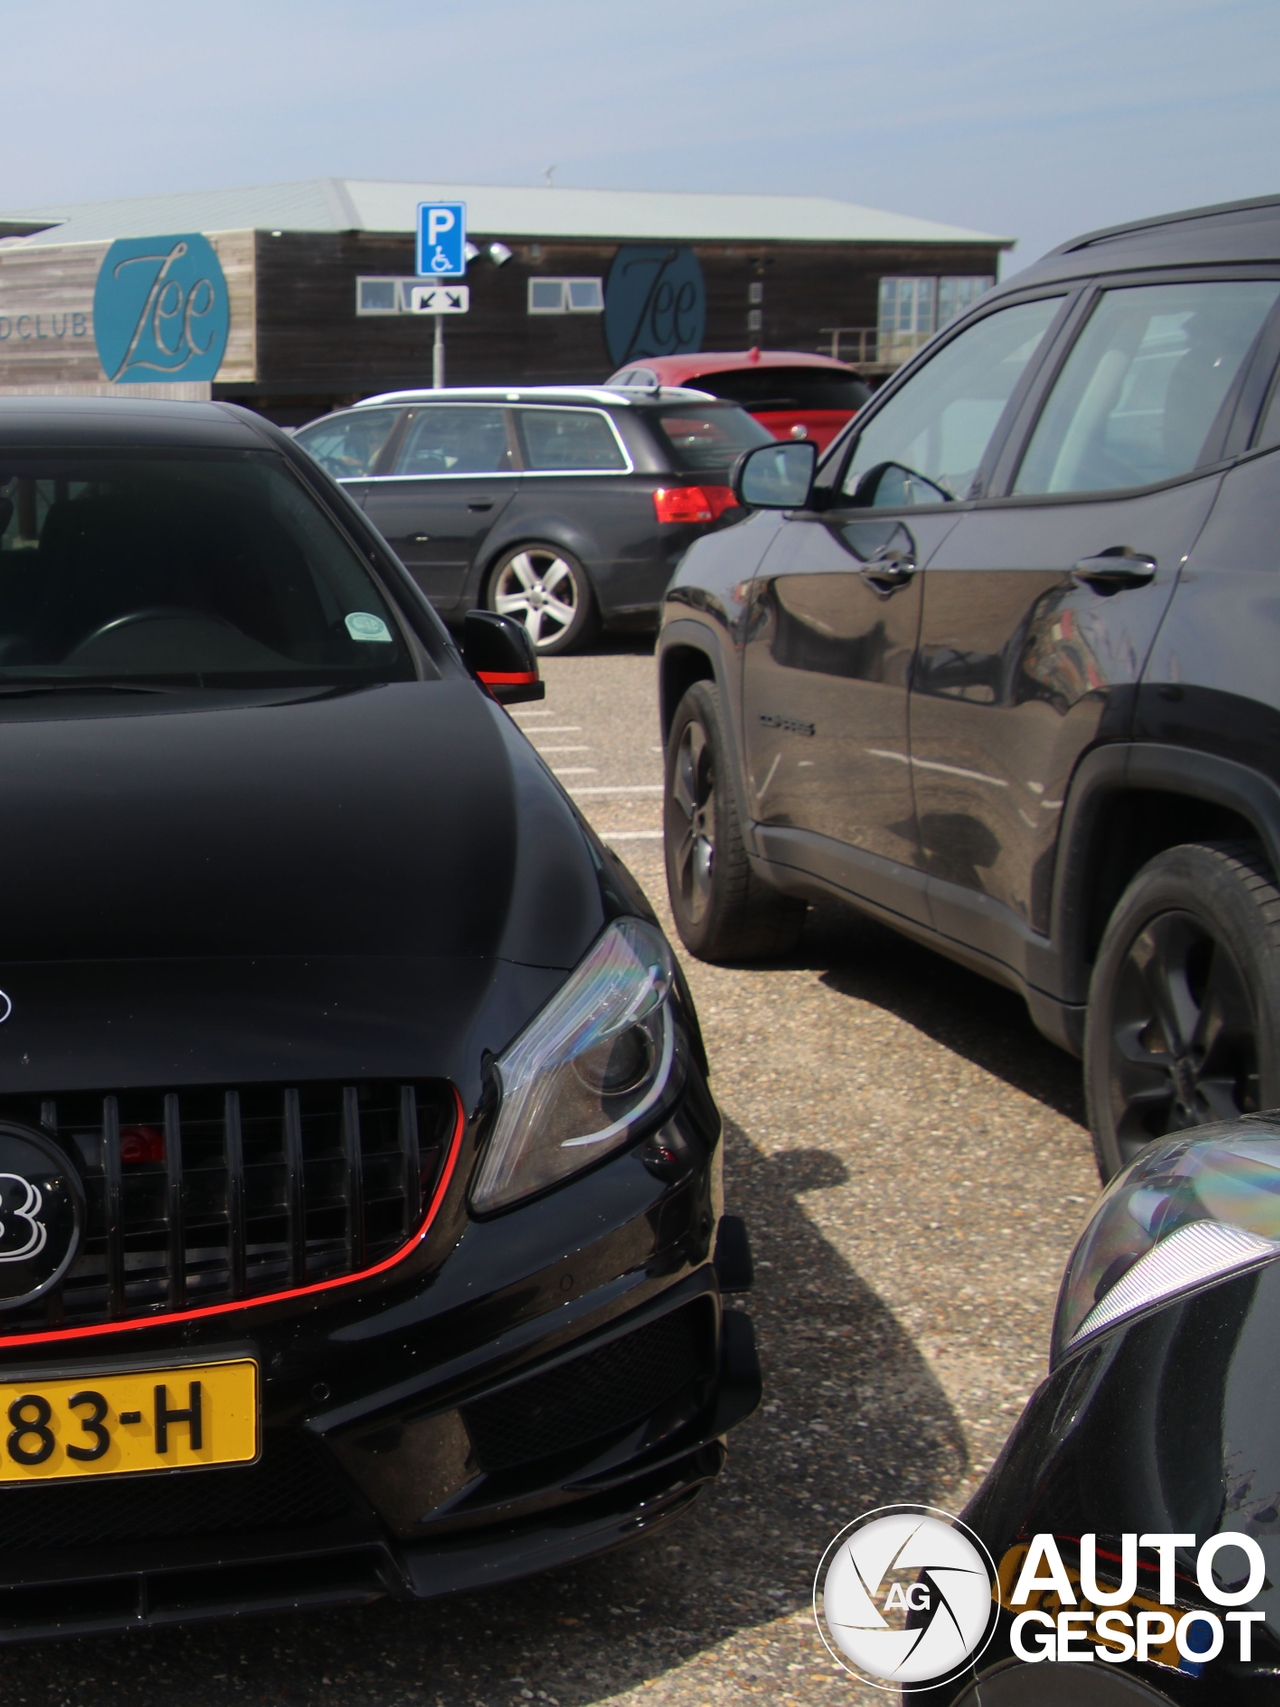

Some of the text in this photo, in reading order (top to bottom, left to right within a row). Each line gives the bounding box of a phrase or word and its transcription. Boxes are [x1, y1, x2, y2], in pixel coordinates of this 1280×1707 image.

[428, 208, 455, 246] P
[111, 240, 216, 384] Zee
[619, 247, 697, 369] Zee
